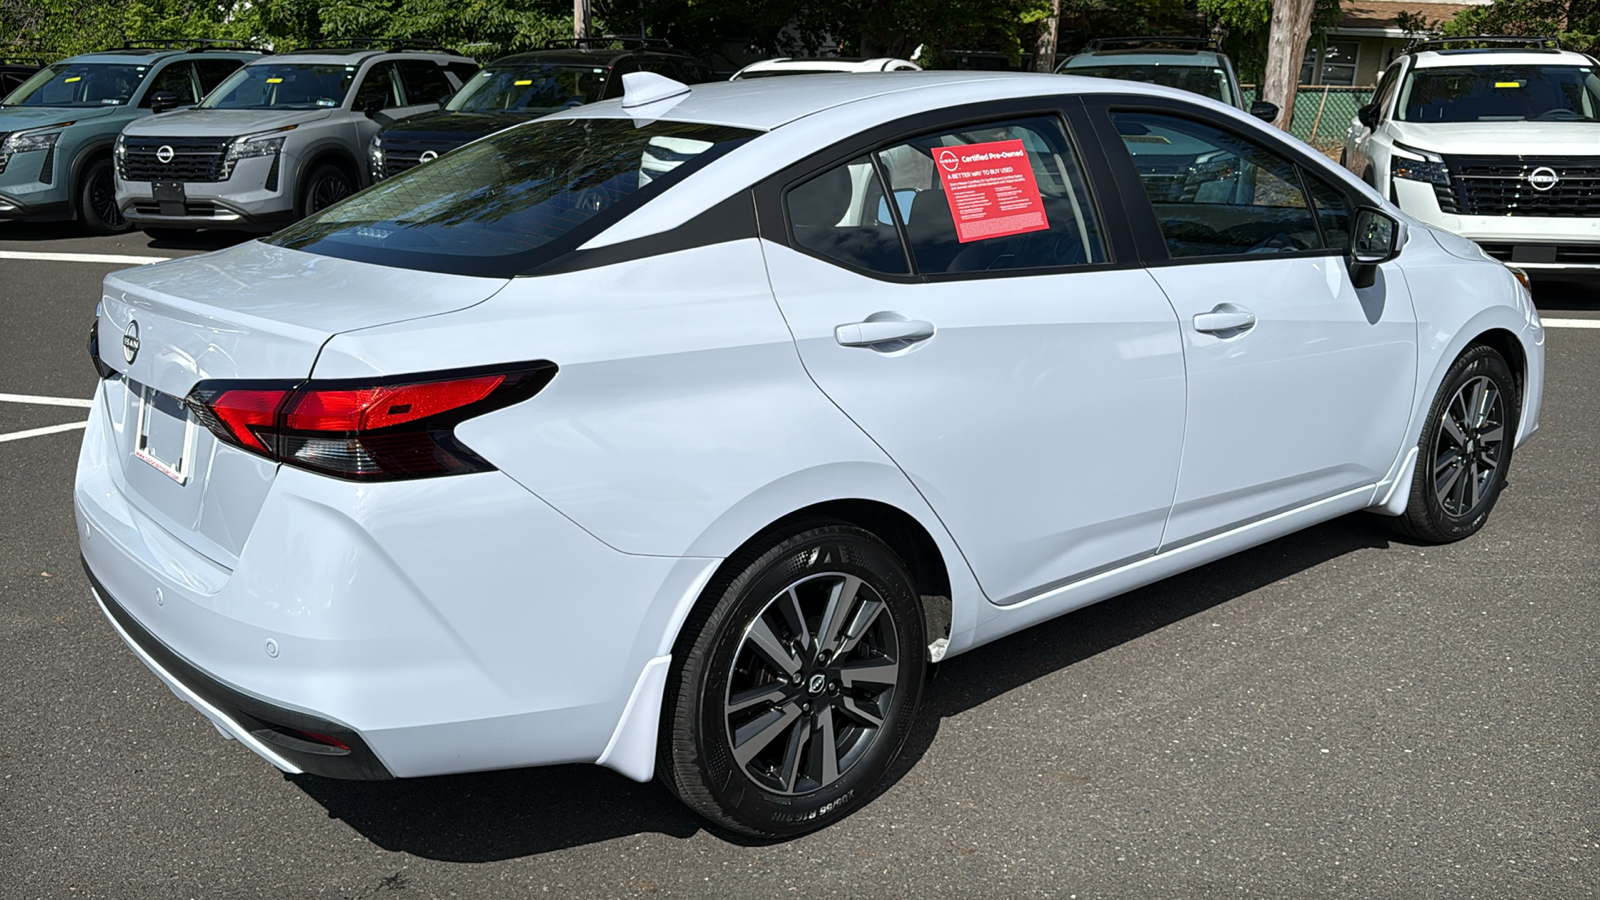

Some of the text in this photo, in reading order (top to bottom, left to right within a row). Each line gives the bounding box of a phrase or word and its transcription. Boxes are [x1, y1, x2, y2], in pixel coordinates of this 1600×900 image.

[961, 149, 1024, 163] Certified Pre-Owned
[951, 171, 971, 179] BETTER
[1000, 166, 1013, 174] USED
